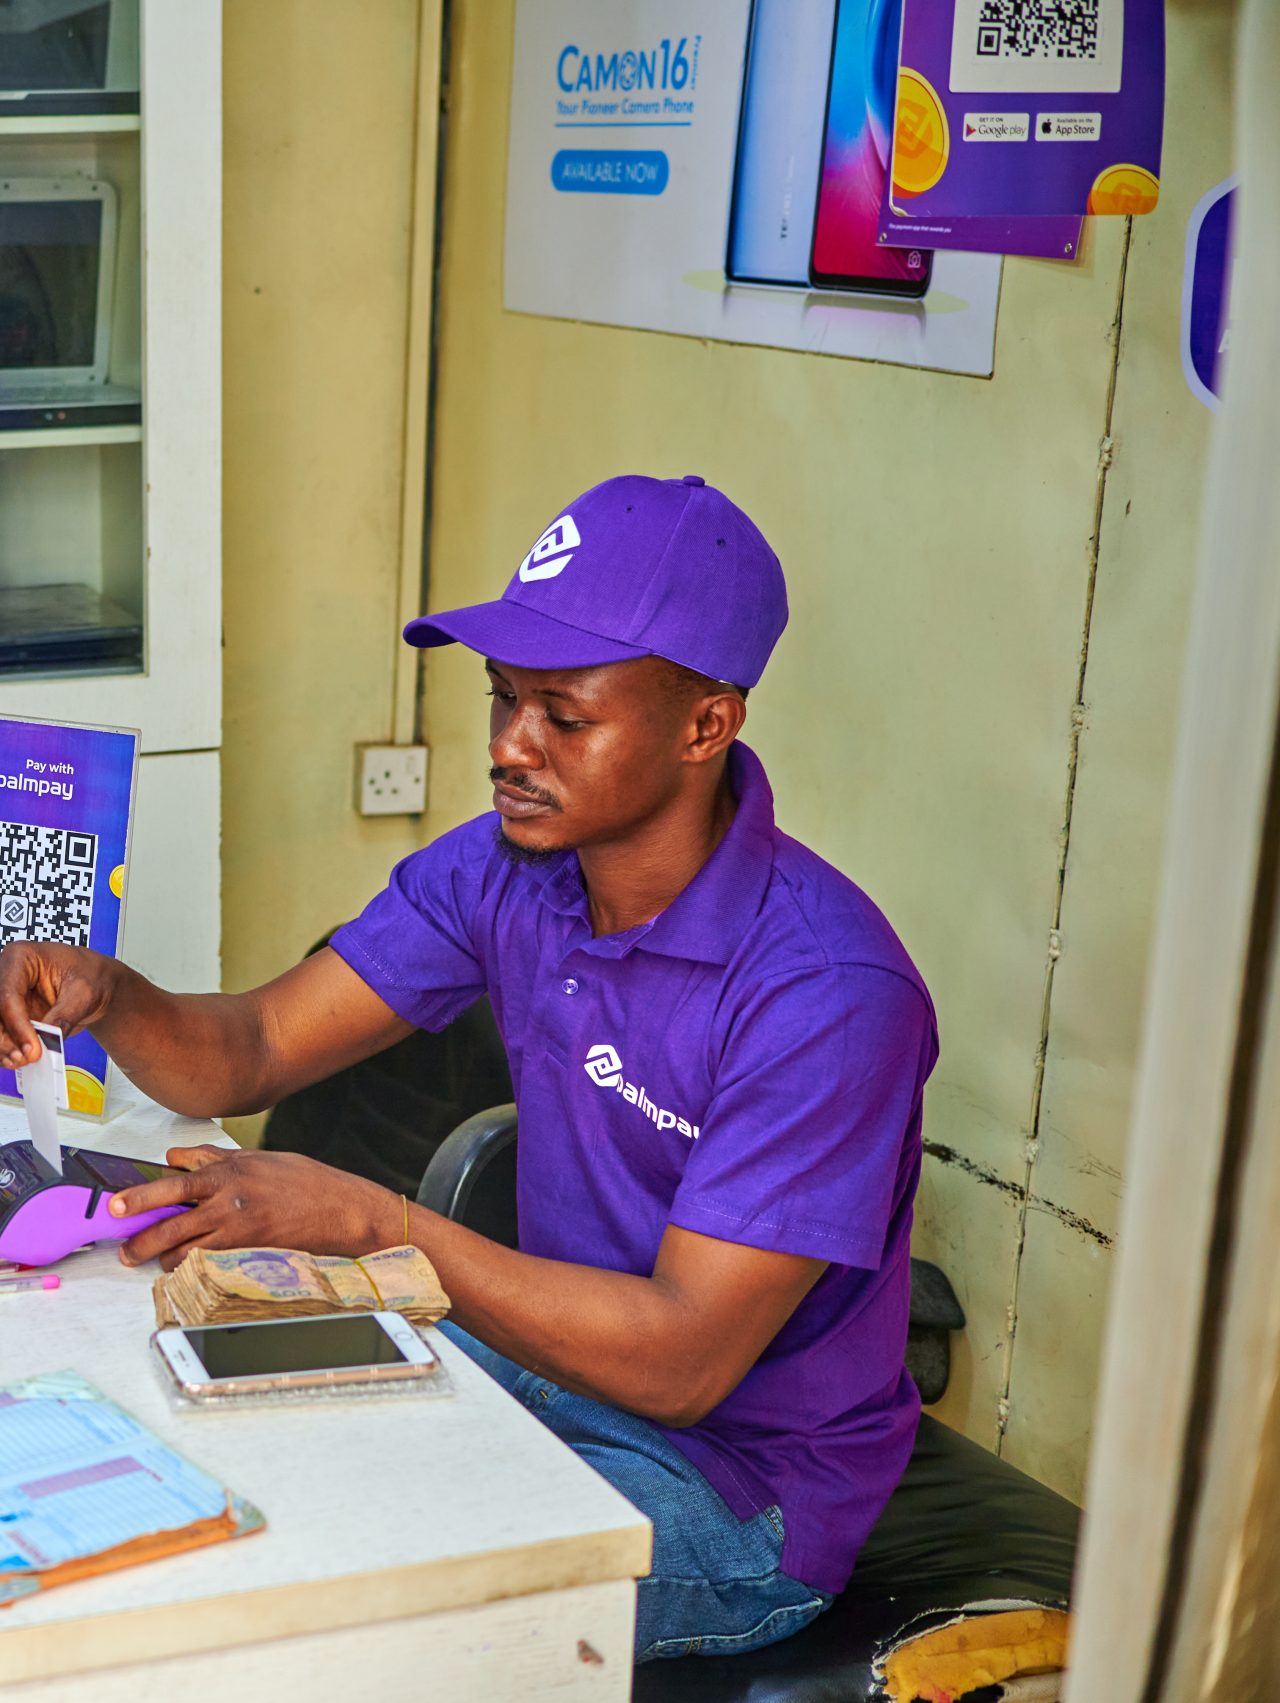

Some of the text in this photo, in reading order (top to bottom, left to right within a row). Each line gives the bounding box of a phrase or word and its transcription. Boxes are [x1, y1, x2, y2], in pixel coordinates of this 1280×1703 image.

[557, 97, 694, 115] Your Pioneer Camera Phone
[978, 124, 1027, 138] Google play
[1055, 125, 1095, 136] App Store
[562, 162, 660, 183] AVAILABLE NOW
[26, 759, 74, 775] Pay with
